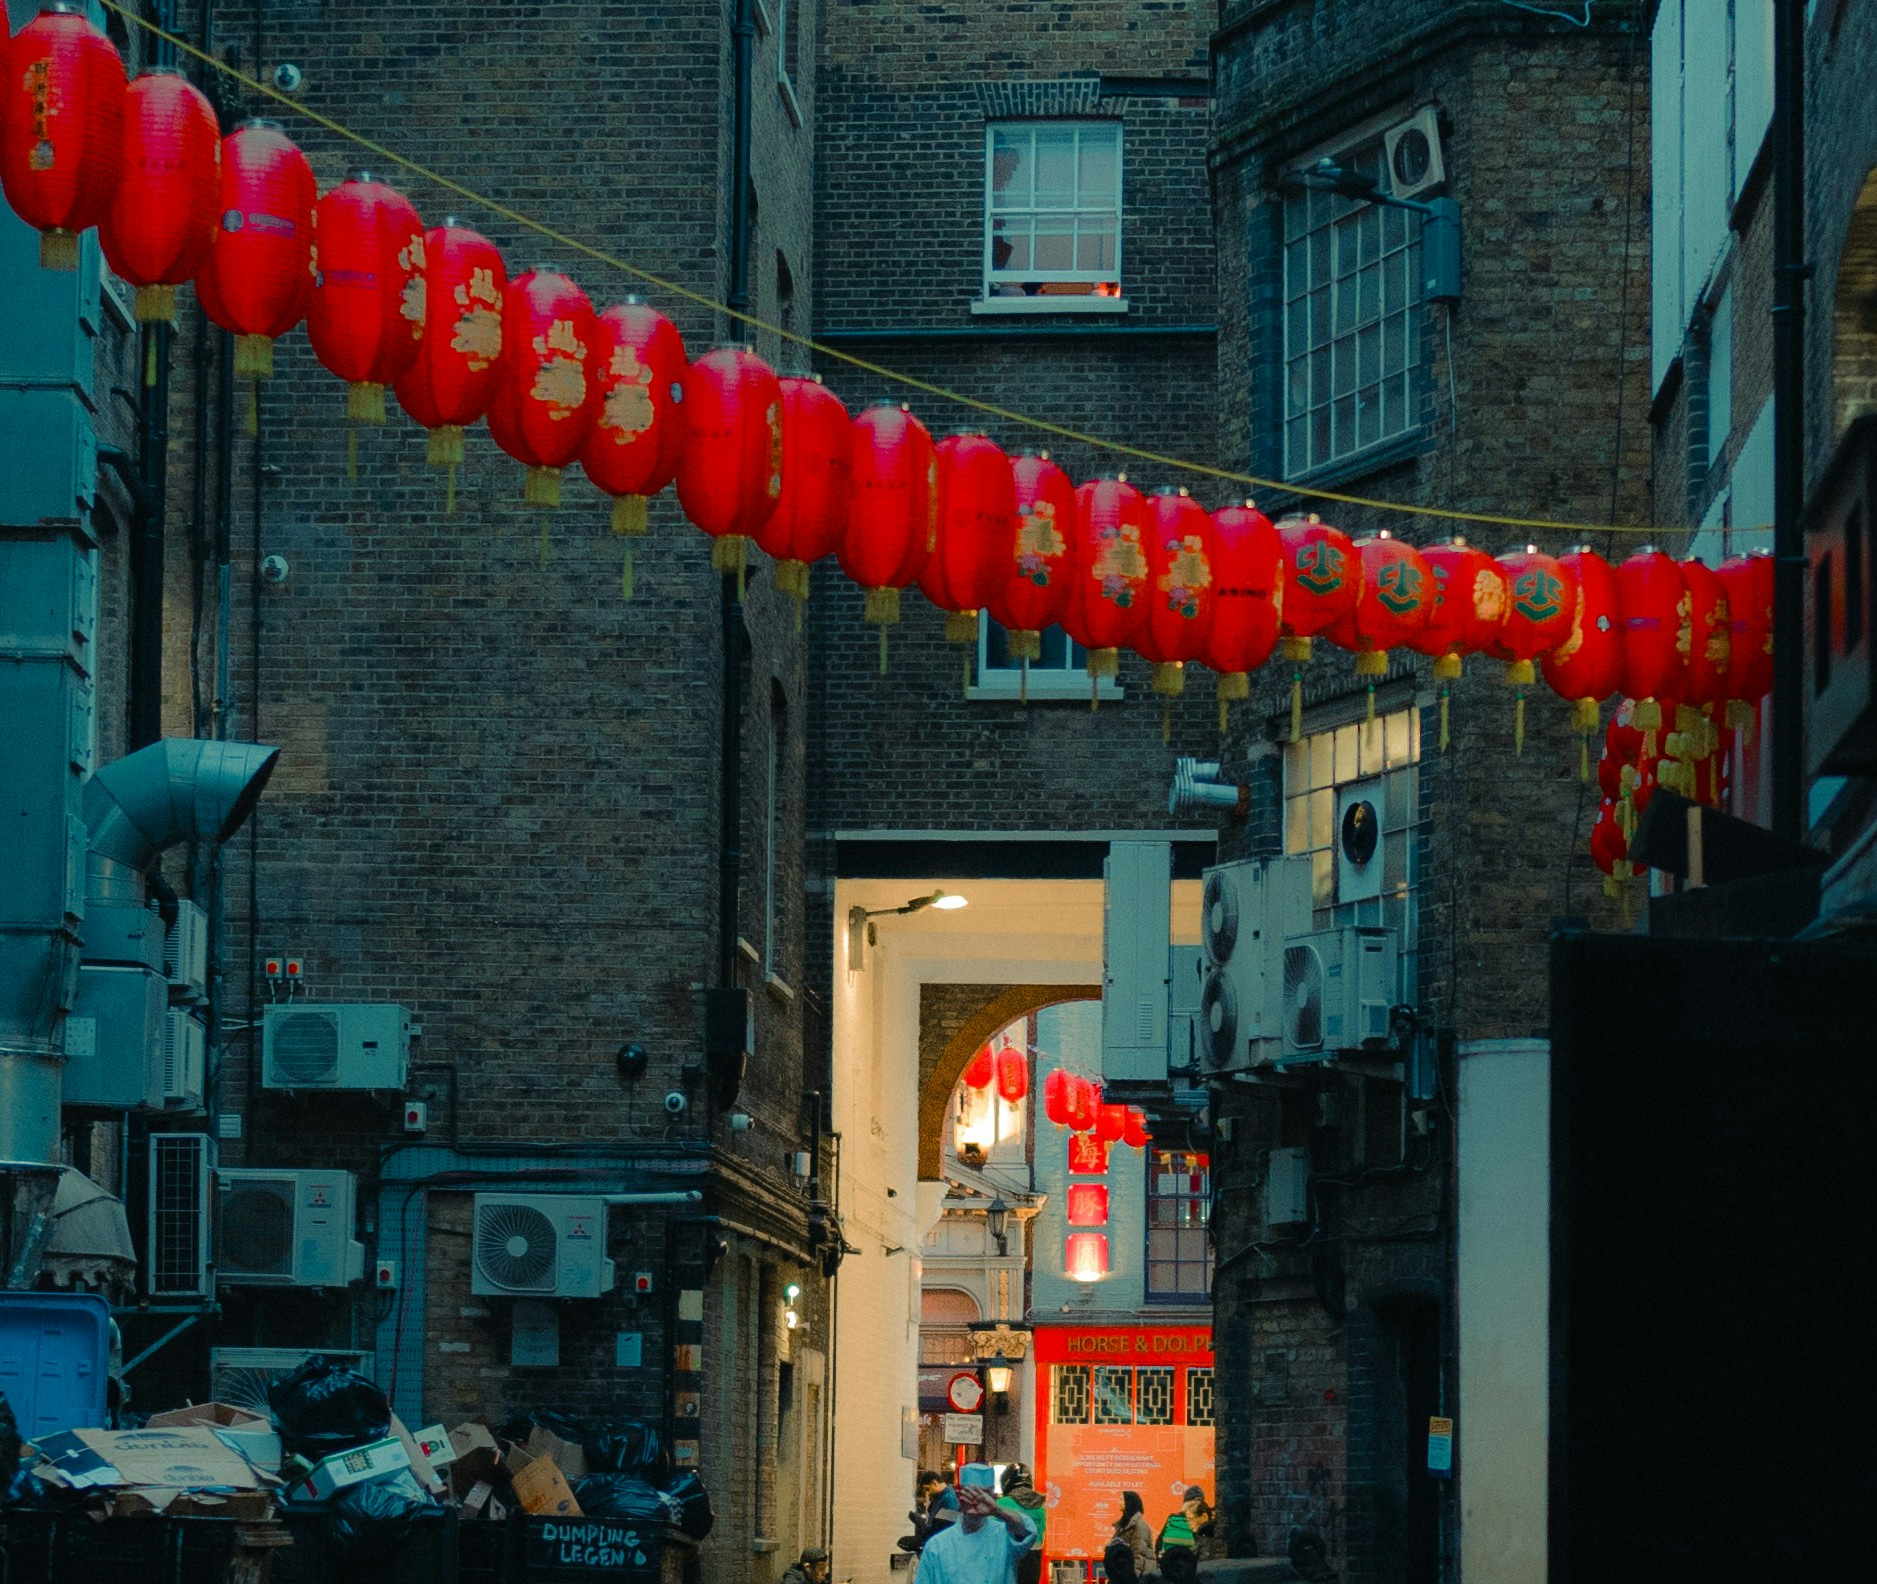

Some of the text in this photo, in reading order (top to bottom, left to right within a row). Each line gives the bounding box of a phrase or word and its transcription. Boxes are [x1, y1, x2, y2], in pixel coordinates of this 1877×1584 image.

[1067, 1335, 1130, 1352] HORSE
[1135, 1335, 1148, 1352] &
[542, 1522, 641, 1547] DUMPLING
